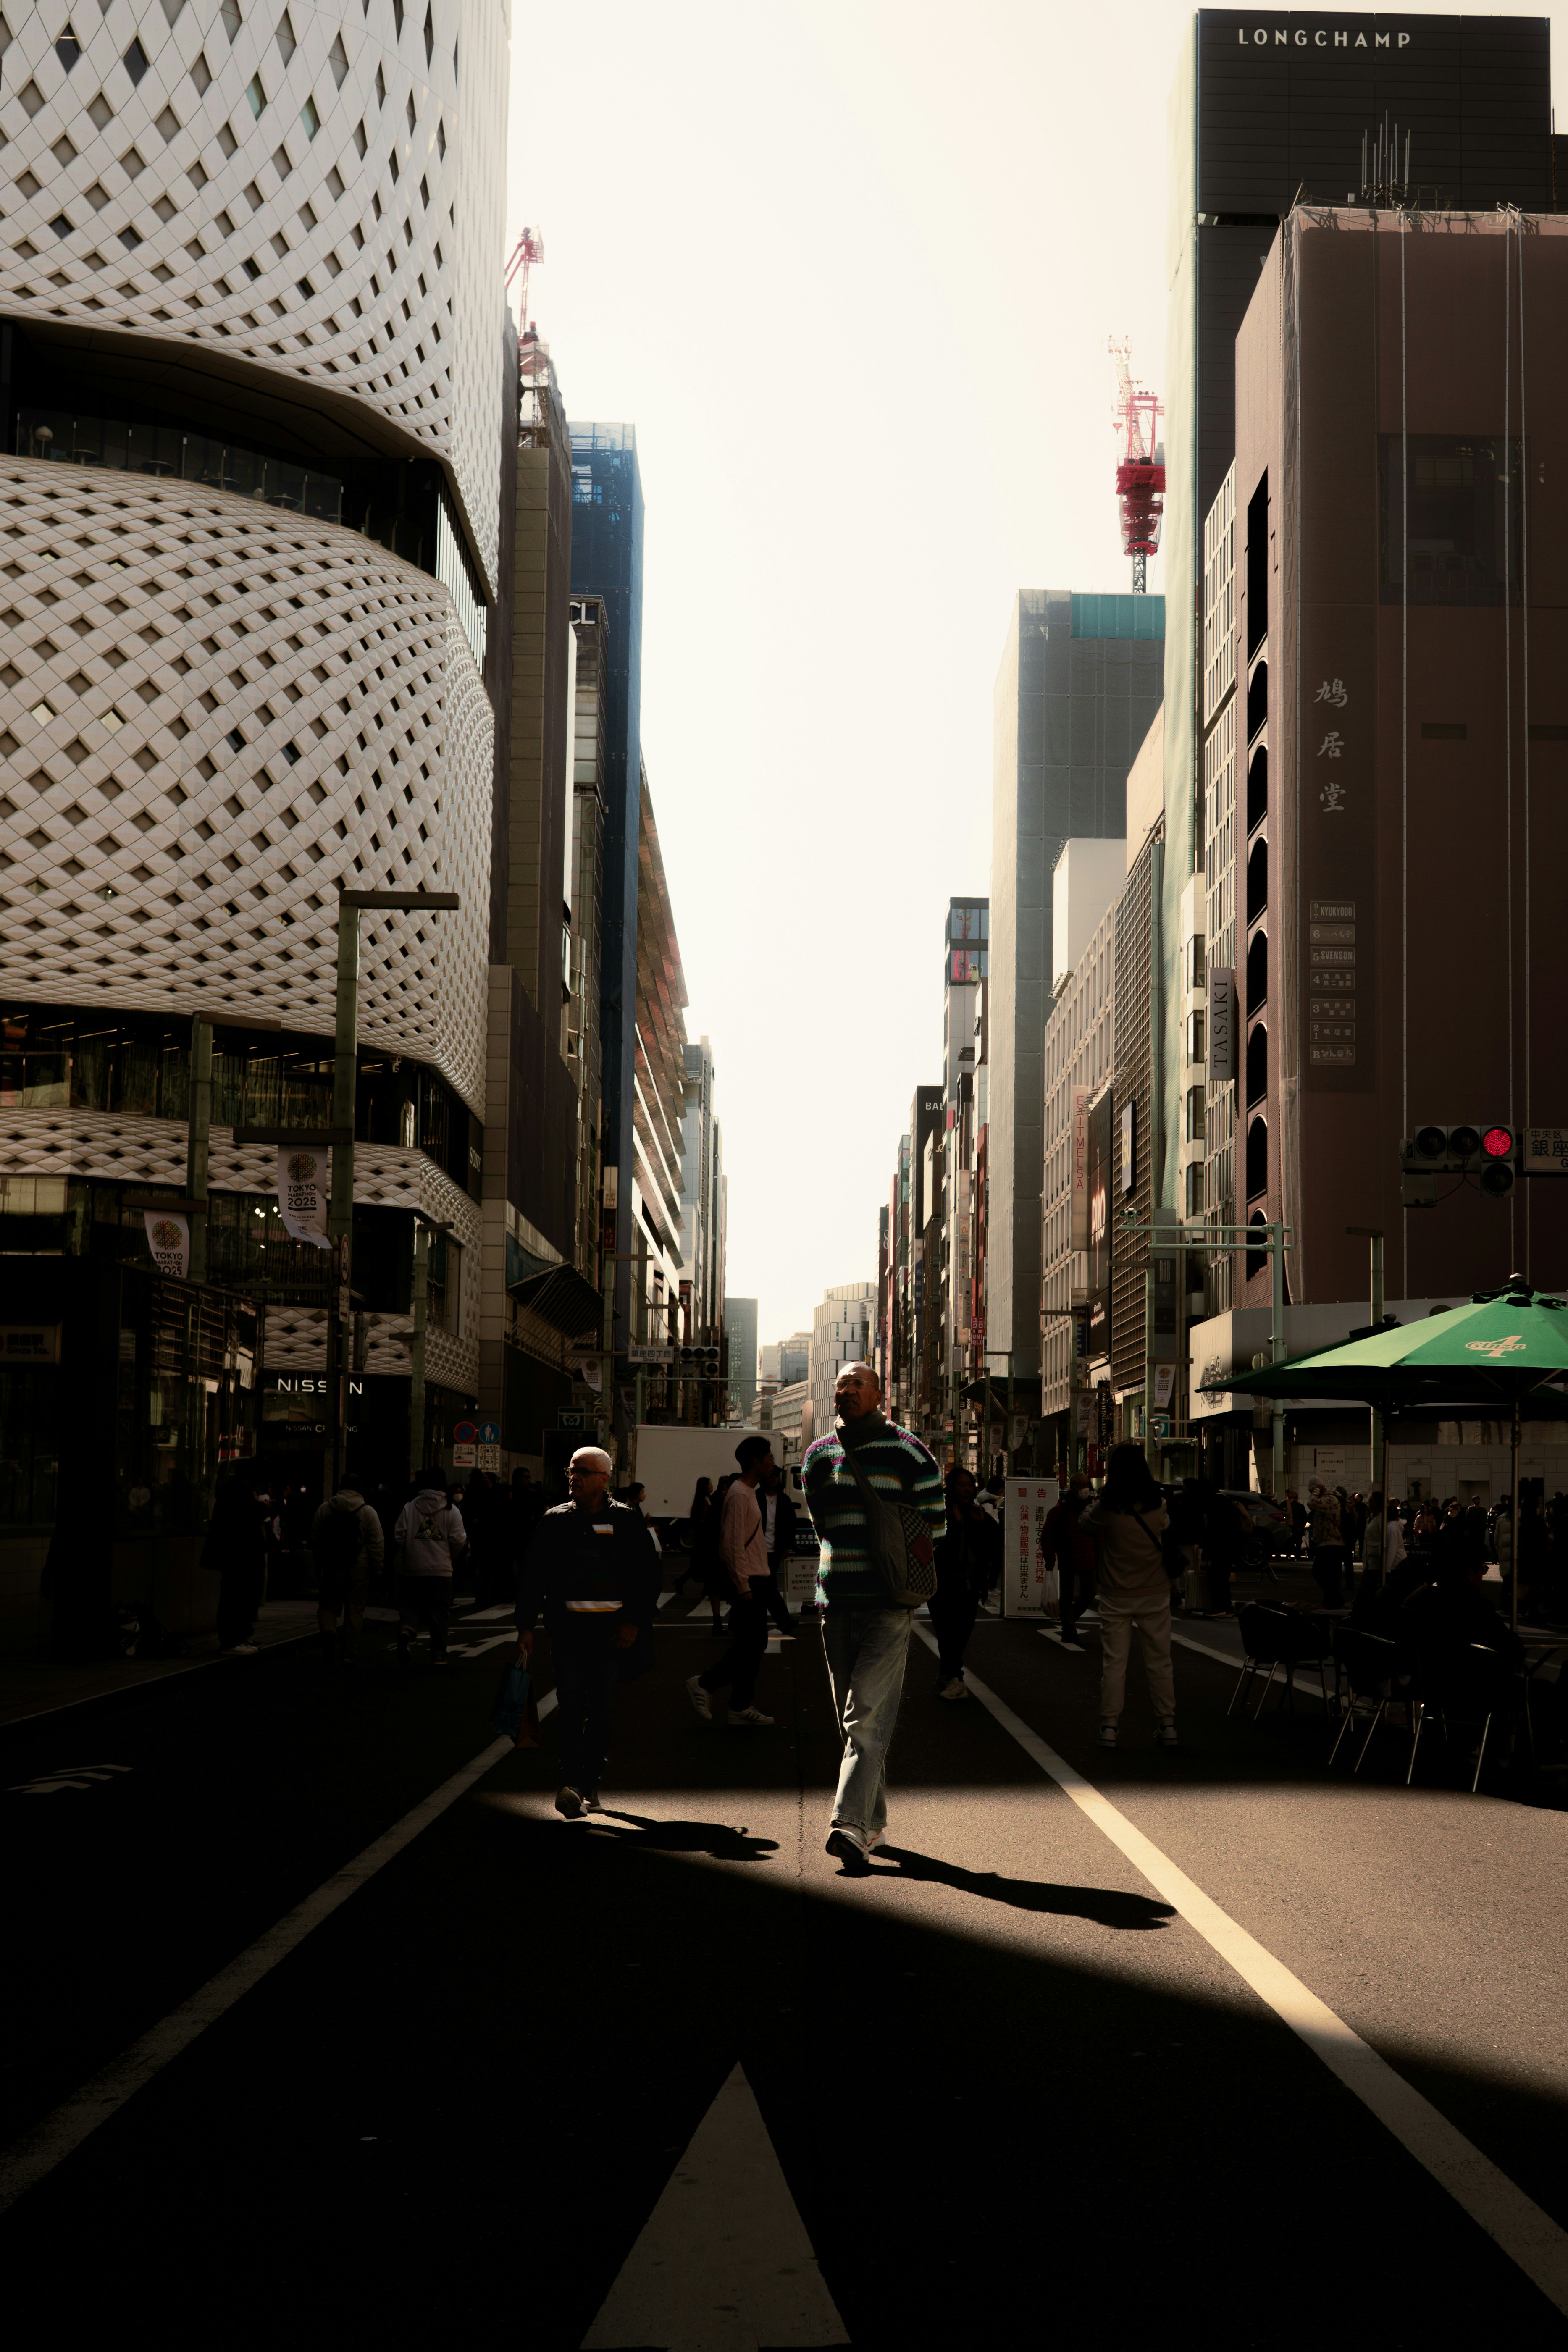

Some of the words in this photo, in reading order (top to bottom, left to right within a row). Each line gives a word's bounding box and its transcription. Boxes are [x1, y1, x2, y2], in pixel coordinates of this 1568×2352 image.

[1239, 29, 1410, 48] LONGCHAMP
[1313, 678, 1348, 812] 鳩居堂
[1321, 907, 1353, 916] KYUKYODO
[1313, 929, 1320, 938] 6
[1321, 951, 1353, 960] SVENSON
[1313, 1005, 1320, 1013] 3
[1213, 981, 1227, 1068] TASAKI
[1313, 1050, 1320, 1059] B
[1076, 1095, 1085, 1189] EXITMELSA
[1531, 1130, 1562, 1139] 中央区
[1122, 1127, 1132, 1168] GU
[1531, 1139, 1568, 1157] 銀座
[470, 1146, 481, 1173] SONY
[288, 1197, 316, 1206] 2025
[7, 1334, 44, 1346] 銀座駅
[278, 1378, 362, 1394] NISSN
[1018, 1488, 1047, 1498] 警告
[1035, 1506, 1044, 1584] 道路上での人寄せ行為
[1020, 1505, 1029, 1602] 公演・物品販売は出来ません。
